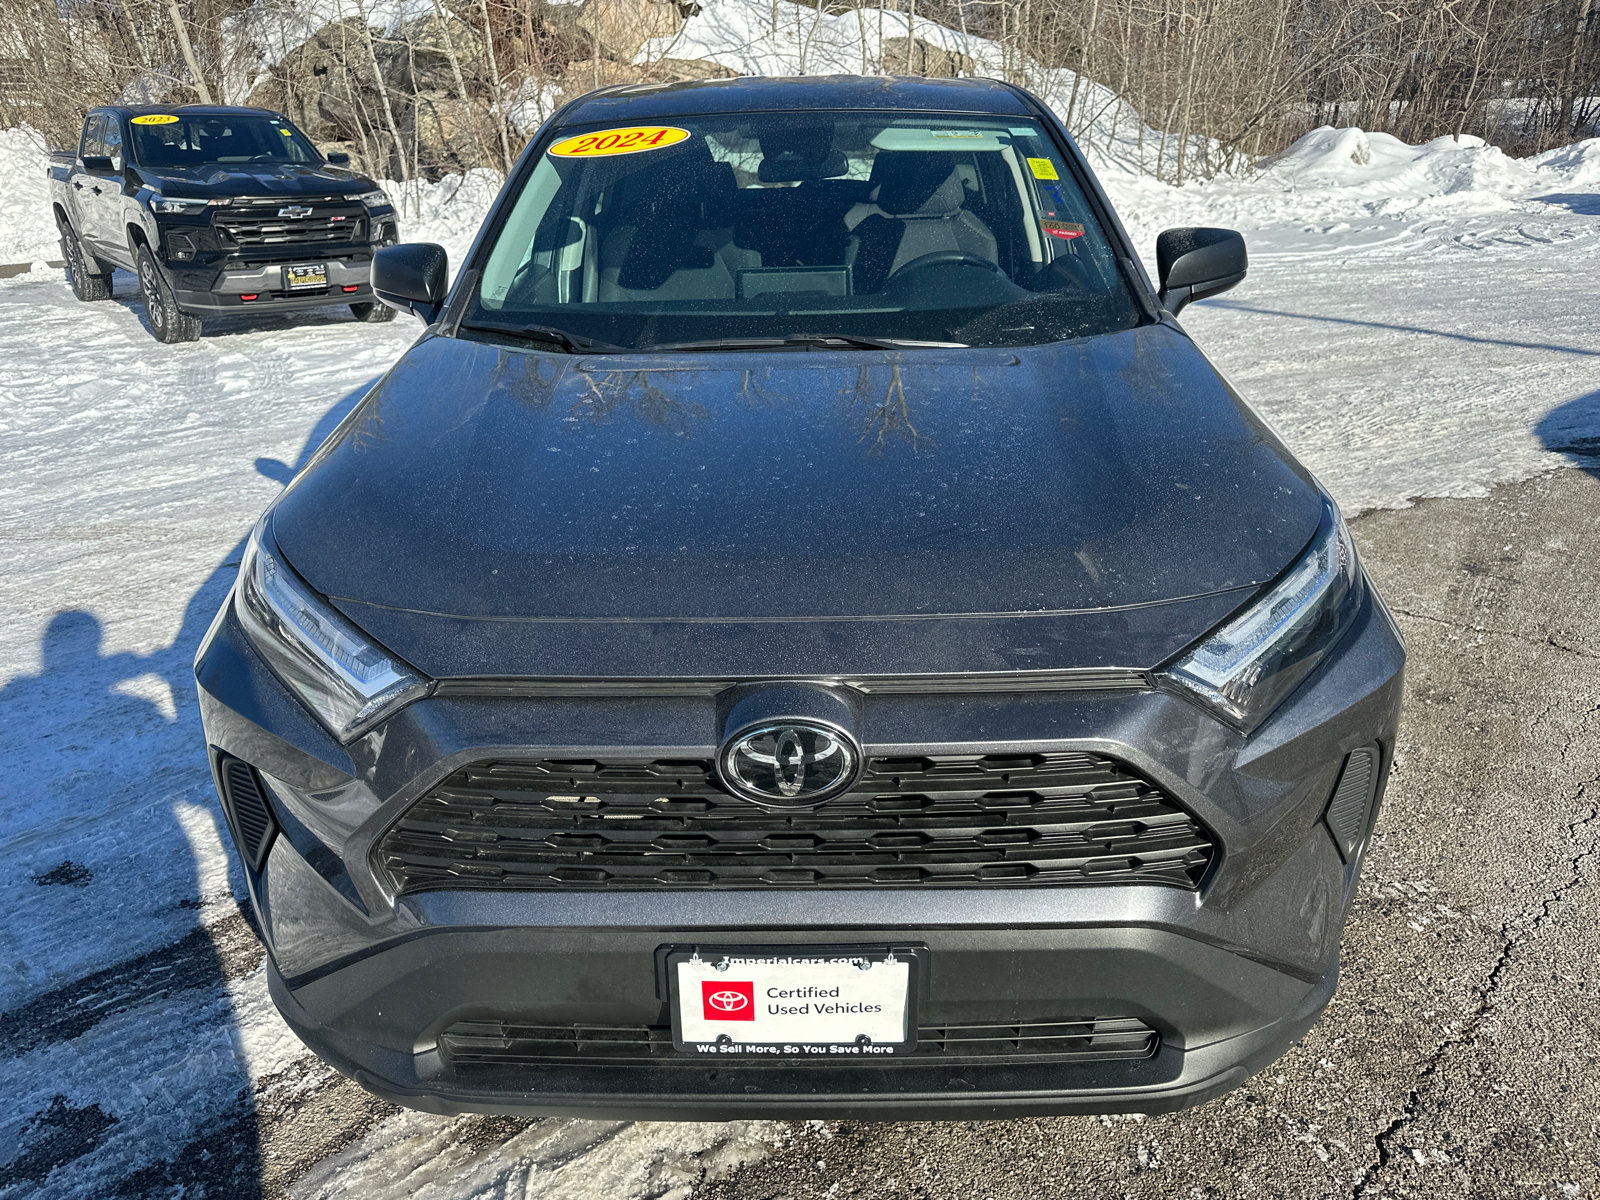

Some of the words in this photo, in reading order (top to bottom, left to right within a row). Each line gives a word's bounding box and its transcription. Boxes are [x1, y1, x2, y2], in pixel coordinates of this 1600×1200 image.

[141, 116, 171, 124] 2023
[569, 129, 668, 154] 2024
[1043, 221, 1061, 230] 160
[722, 955, 864, 966] Imperialcars.com
[766, 986, 840, 999] Certified
[767, 1003, 809, 1015] Used
[813, 1001, 882, 1015] Vehicles
[696, 1044, 717, 1054] We
[719, 1044, 742, 1054] Sell
[745, 1044, 781, 1055] More,
[783, 1044, 800, 1054] So
[802, 1044, 827, 1054] You
[829, 1044, 860, 1054] Save
[862, 1044, 894, 1054] More
